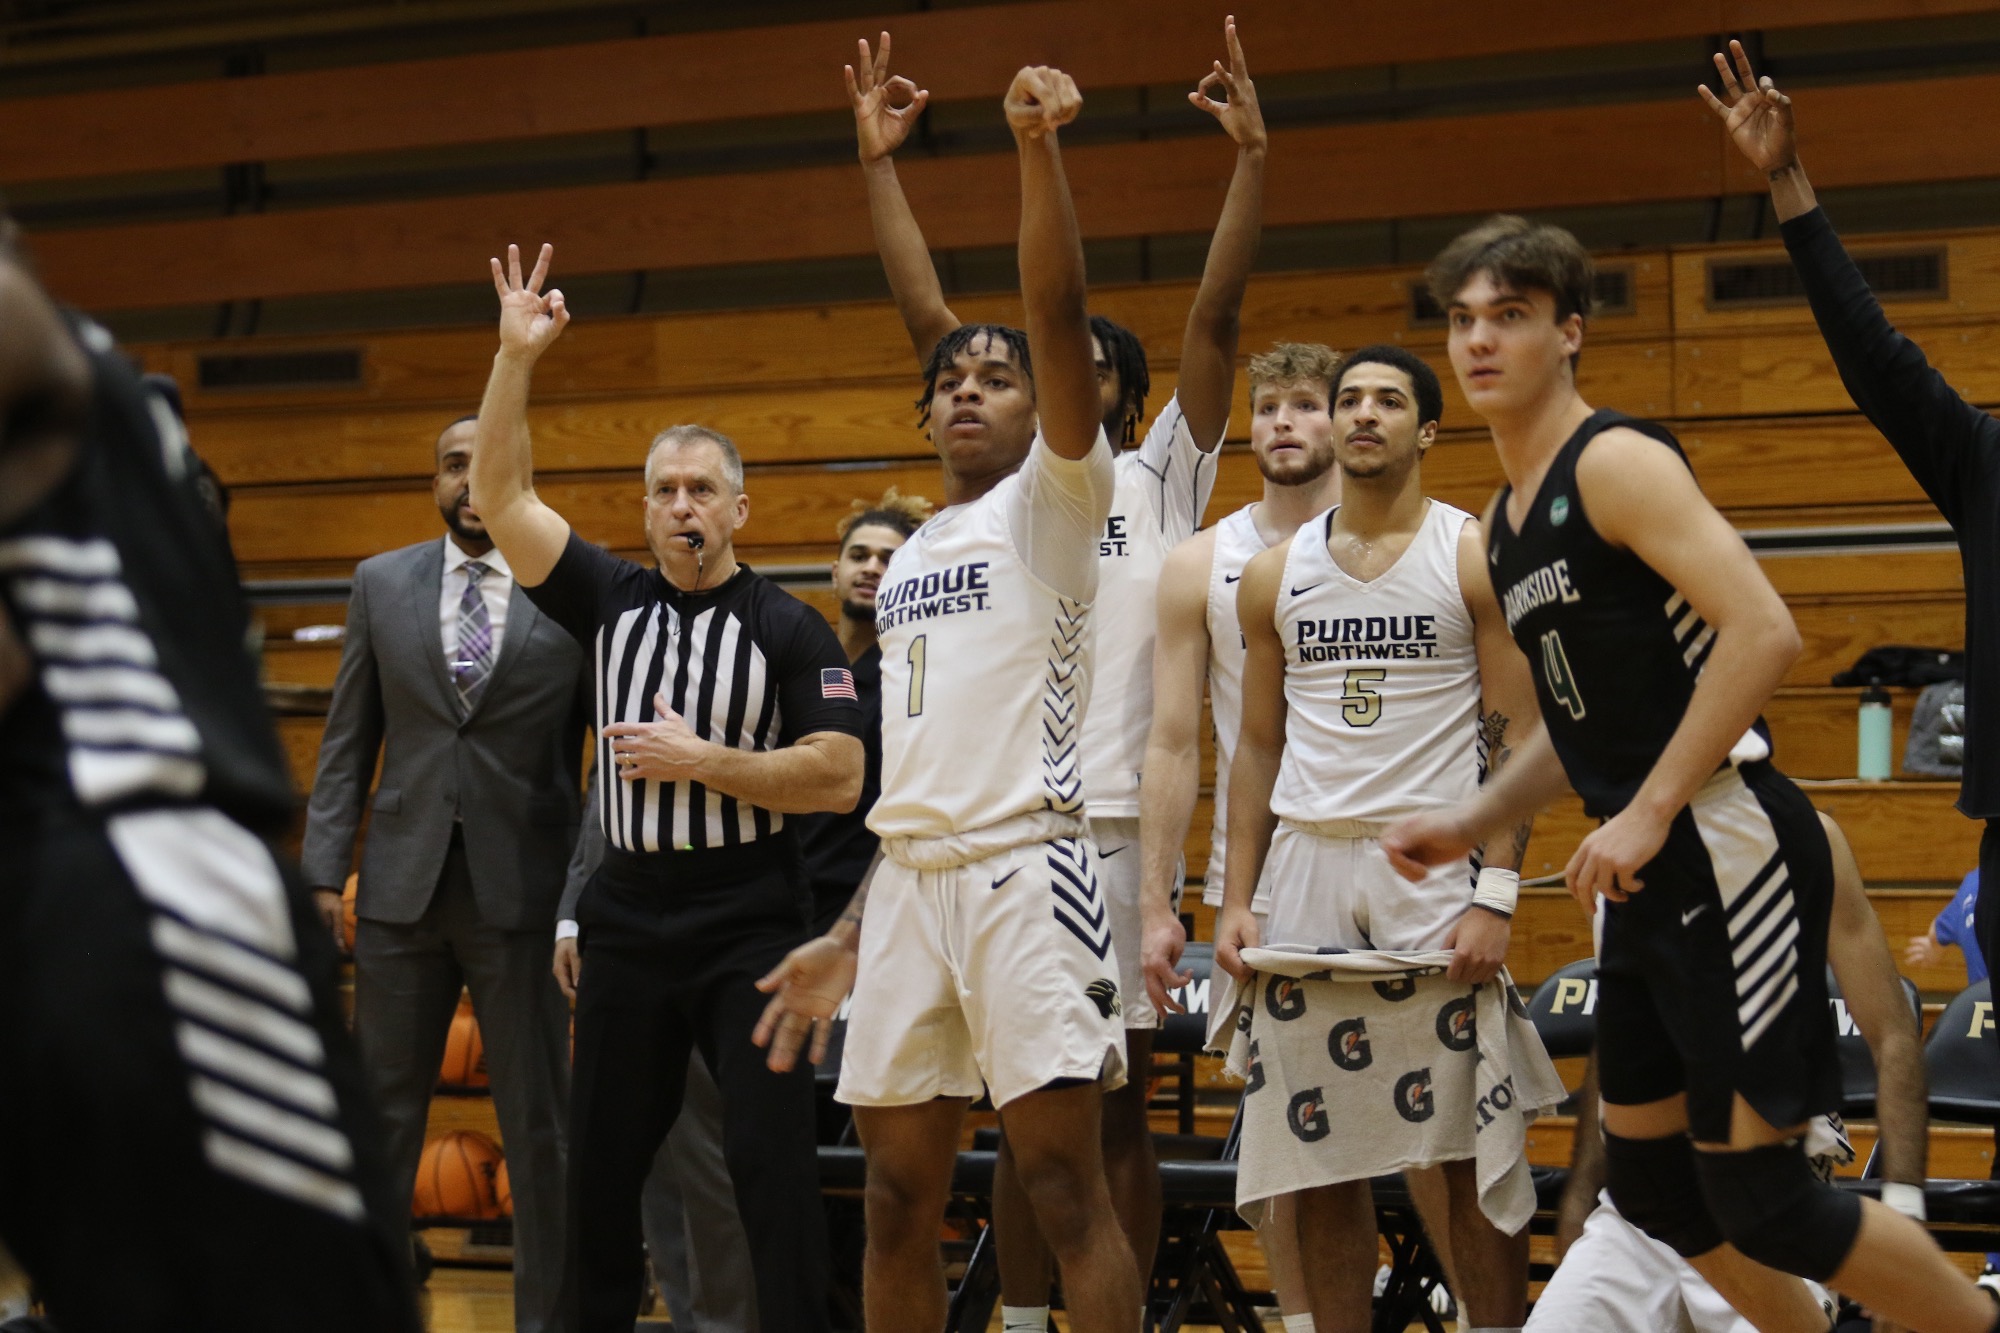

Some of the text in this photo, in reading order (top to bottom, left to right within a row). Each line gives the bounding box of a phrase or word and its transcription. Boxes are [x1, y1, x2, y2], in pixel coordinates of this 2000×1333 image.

[878, 562, 989, 612] PURDUE
[1297, 615, 1437, 645] PURDUE
[1299, 643, 1437, 662] NORTHWEST
[908, 634, 926, 718] 1
[1340, 668, 1386, 728] 5
[1541, 629, 1586, 721] 4
[1265, 974, 1307, 1022] G
[1328, 1017, 1373, 1072] G
[1287, 1086, 1331, 1142] G
[1393, 1067, 1435, 1123] G
